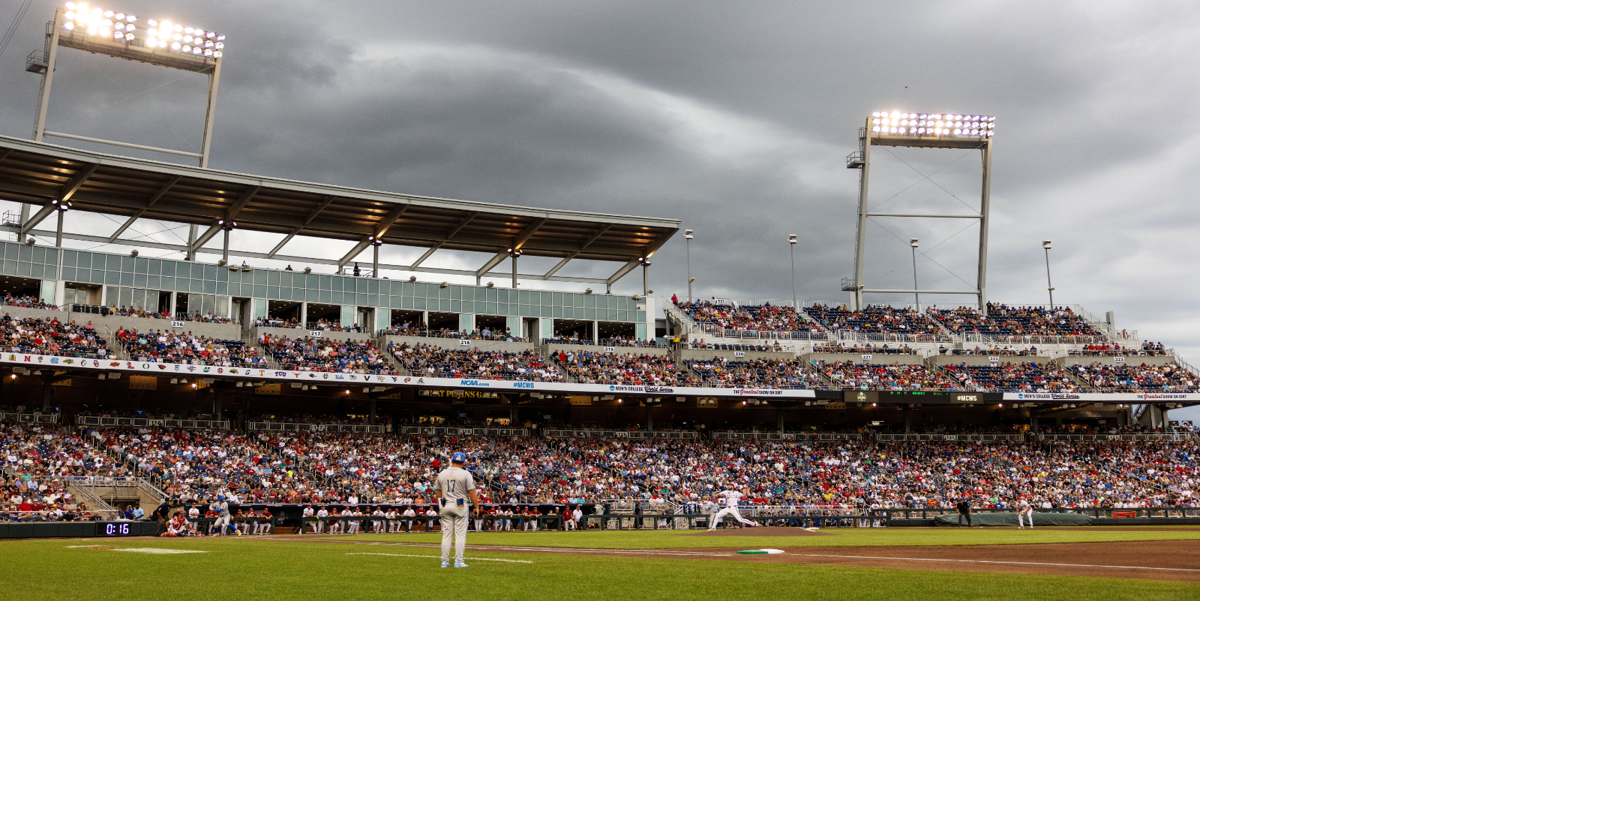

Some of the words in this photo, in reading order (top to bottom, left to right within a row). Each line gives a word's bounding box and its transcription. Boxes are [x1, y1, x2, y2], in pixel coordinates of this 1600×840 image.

[418, 389, 445, 397] GAT
[446, 479, 456, 493] 17
[106, 524, 129, 534] 0:16
